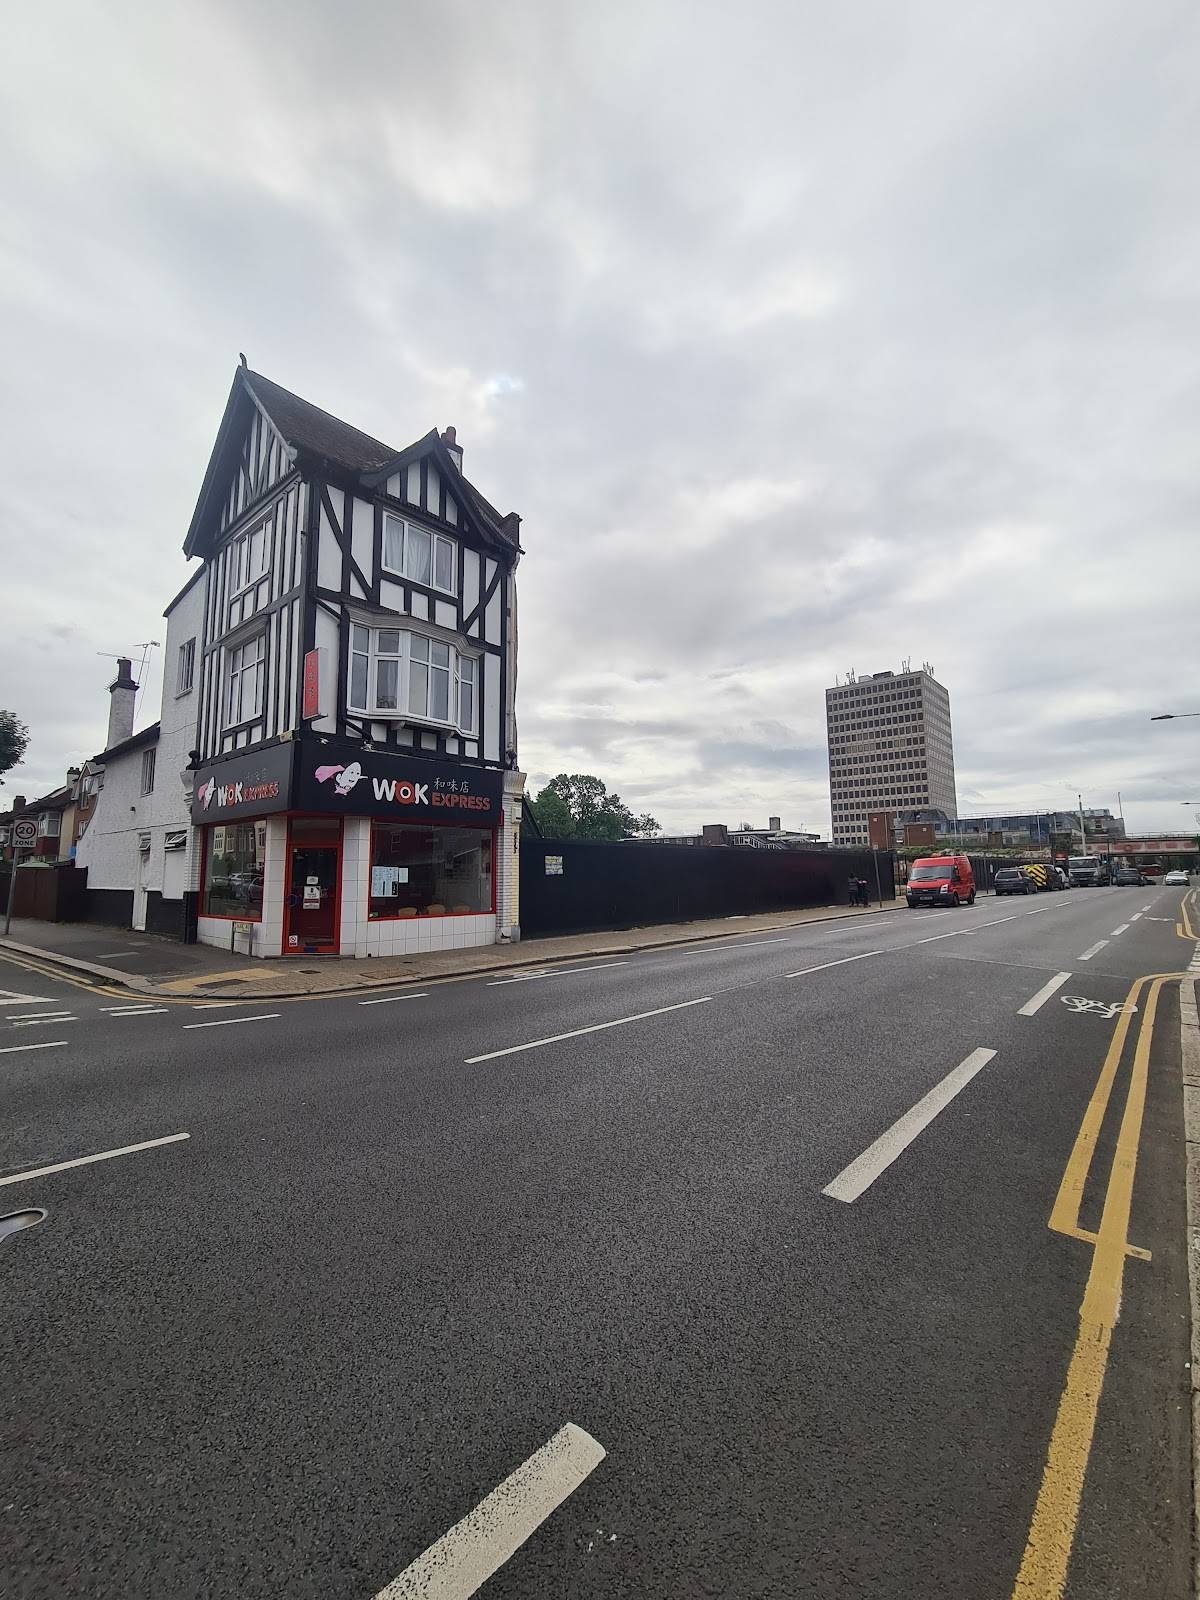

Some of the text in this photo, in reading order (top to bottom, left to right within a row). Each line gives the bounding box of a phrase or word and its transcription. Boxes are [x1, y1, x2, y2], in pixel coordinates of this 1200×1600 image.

[217, 781, 279, 808] WOK EXPRESS
[372, 777, 491, 811] WOK EXPRESS
[434, 777, 470, 793] 和味店
